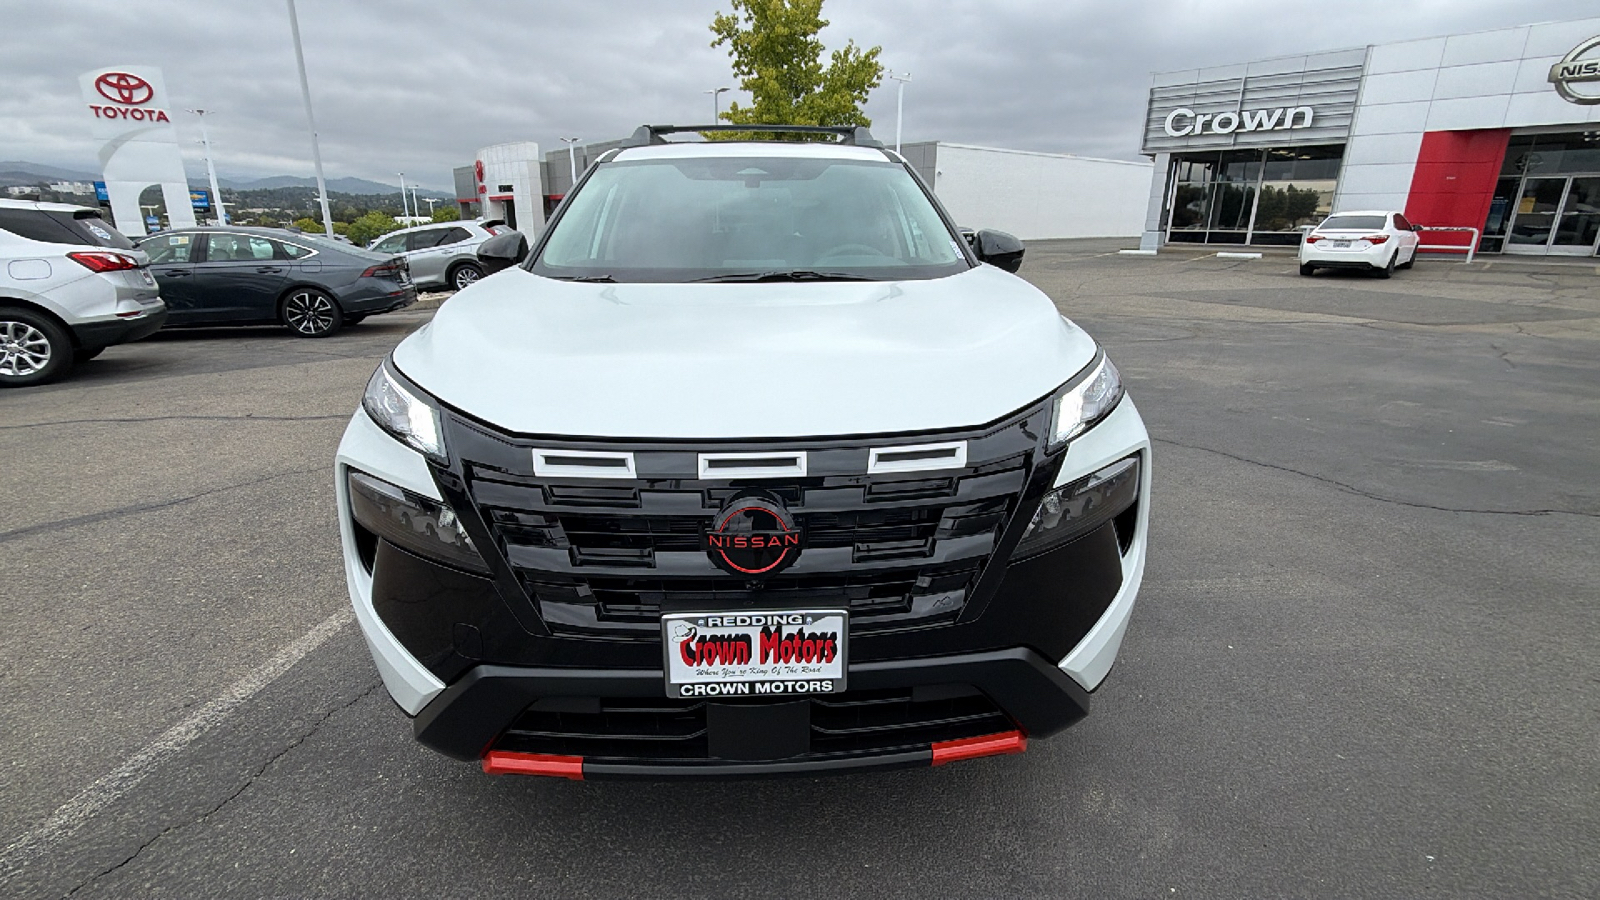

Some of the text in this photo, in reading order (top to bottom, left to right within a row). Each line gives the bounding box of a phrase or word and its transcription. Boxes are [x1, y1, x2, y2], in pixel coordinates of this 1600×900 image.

[1559, 62, 1600, 77] NIS
[89, 105, 170, 123] TOYOTA
[1164, 106, 1314, 137] Crown
[709, 534, 798, 548] NISSAN
[707, 615, 803, 627] REDDING
[679, 626, 838, 667] Crown Motors
[696, 668, 719, 676] Where
[749, 667, 768, 676] King
[771, 666, 781, 676] Of
[784, 666, 799, 674] The
[801, 666, 822, 674] Road
[680, 681, 833, 696] CROWN MOTORS
